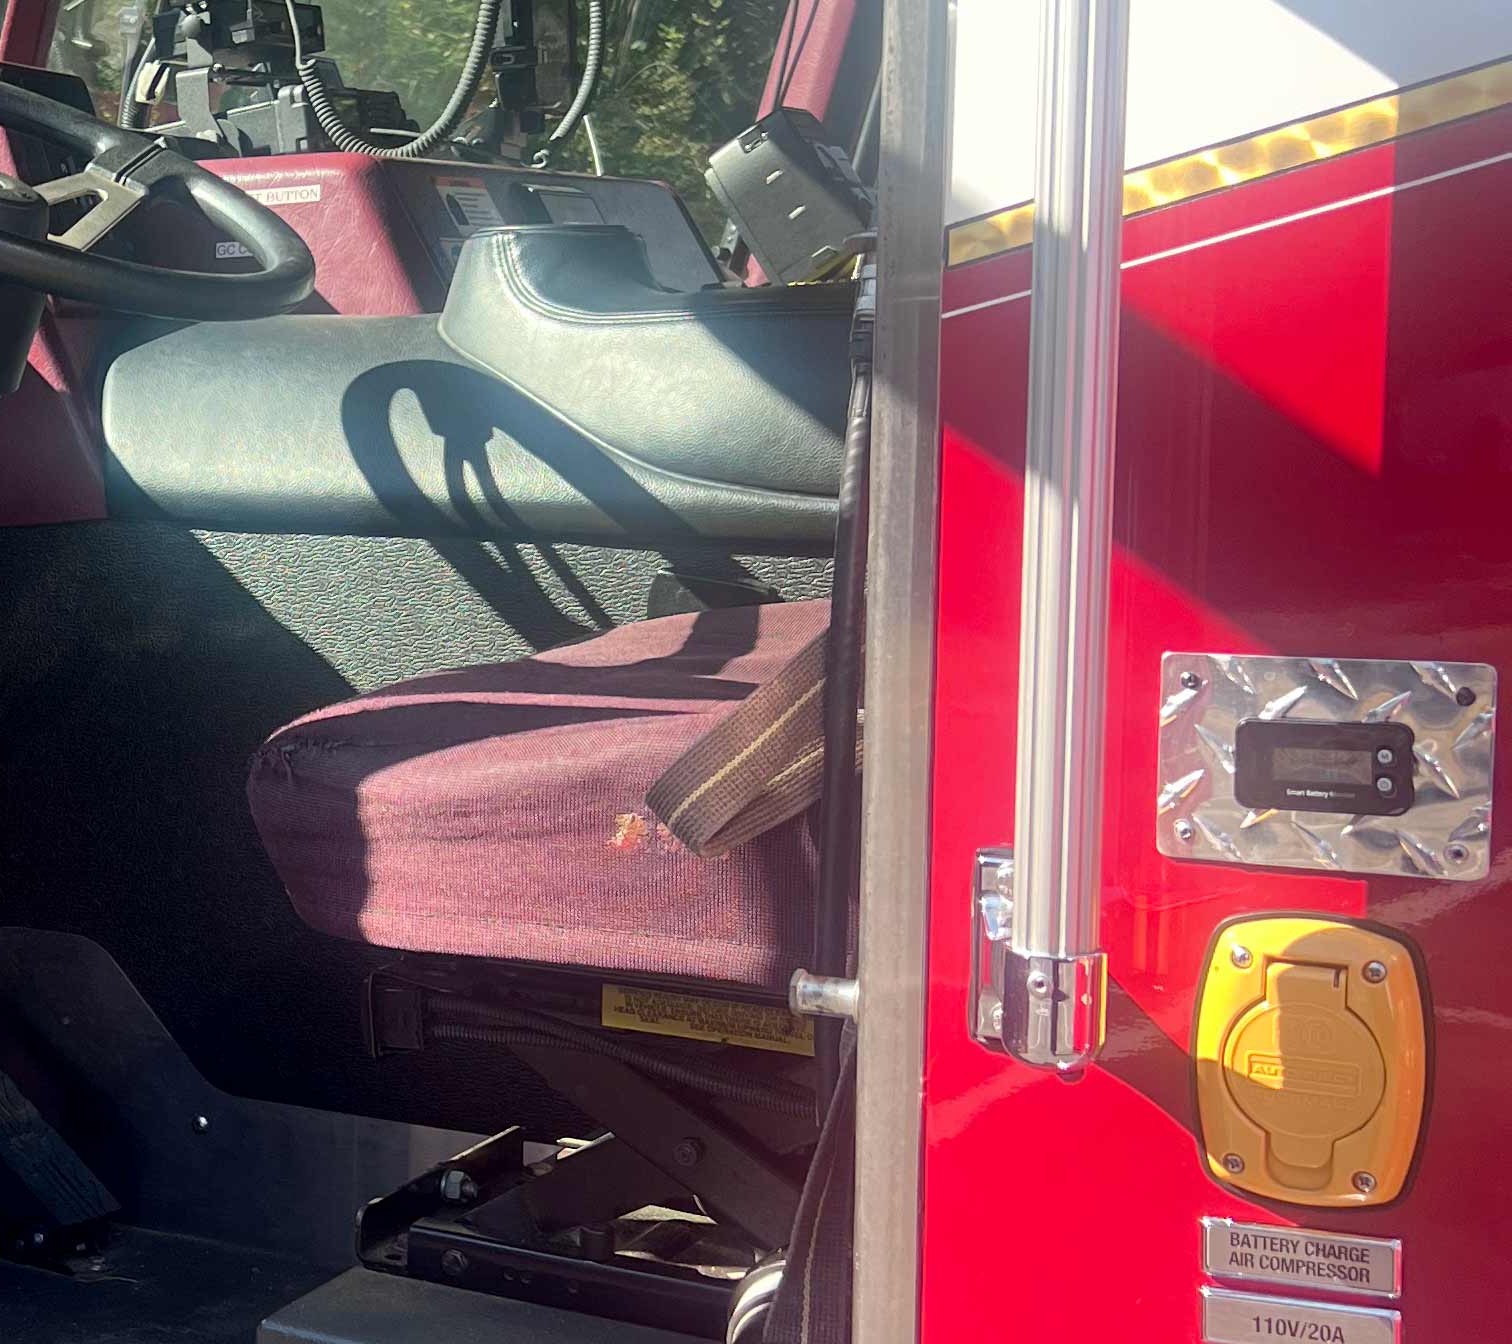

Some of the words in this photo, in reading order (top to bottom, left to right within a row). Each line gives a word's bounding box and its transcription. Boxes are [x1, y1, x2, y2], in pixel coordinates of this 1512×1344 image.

[266, 188, 318, 203] BUTTON
[1229, 1232, 1300, 1254] BATTERY
[1305, 1241, 1370, 1264] CHARGE
[1229, 1252, 1254, 1269] AIR
[1259, 1257, 1370, 1283] COMPRESSOR
[1252, 1315, 1345, 1344] 110V/20A
